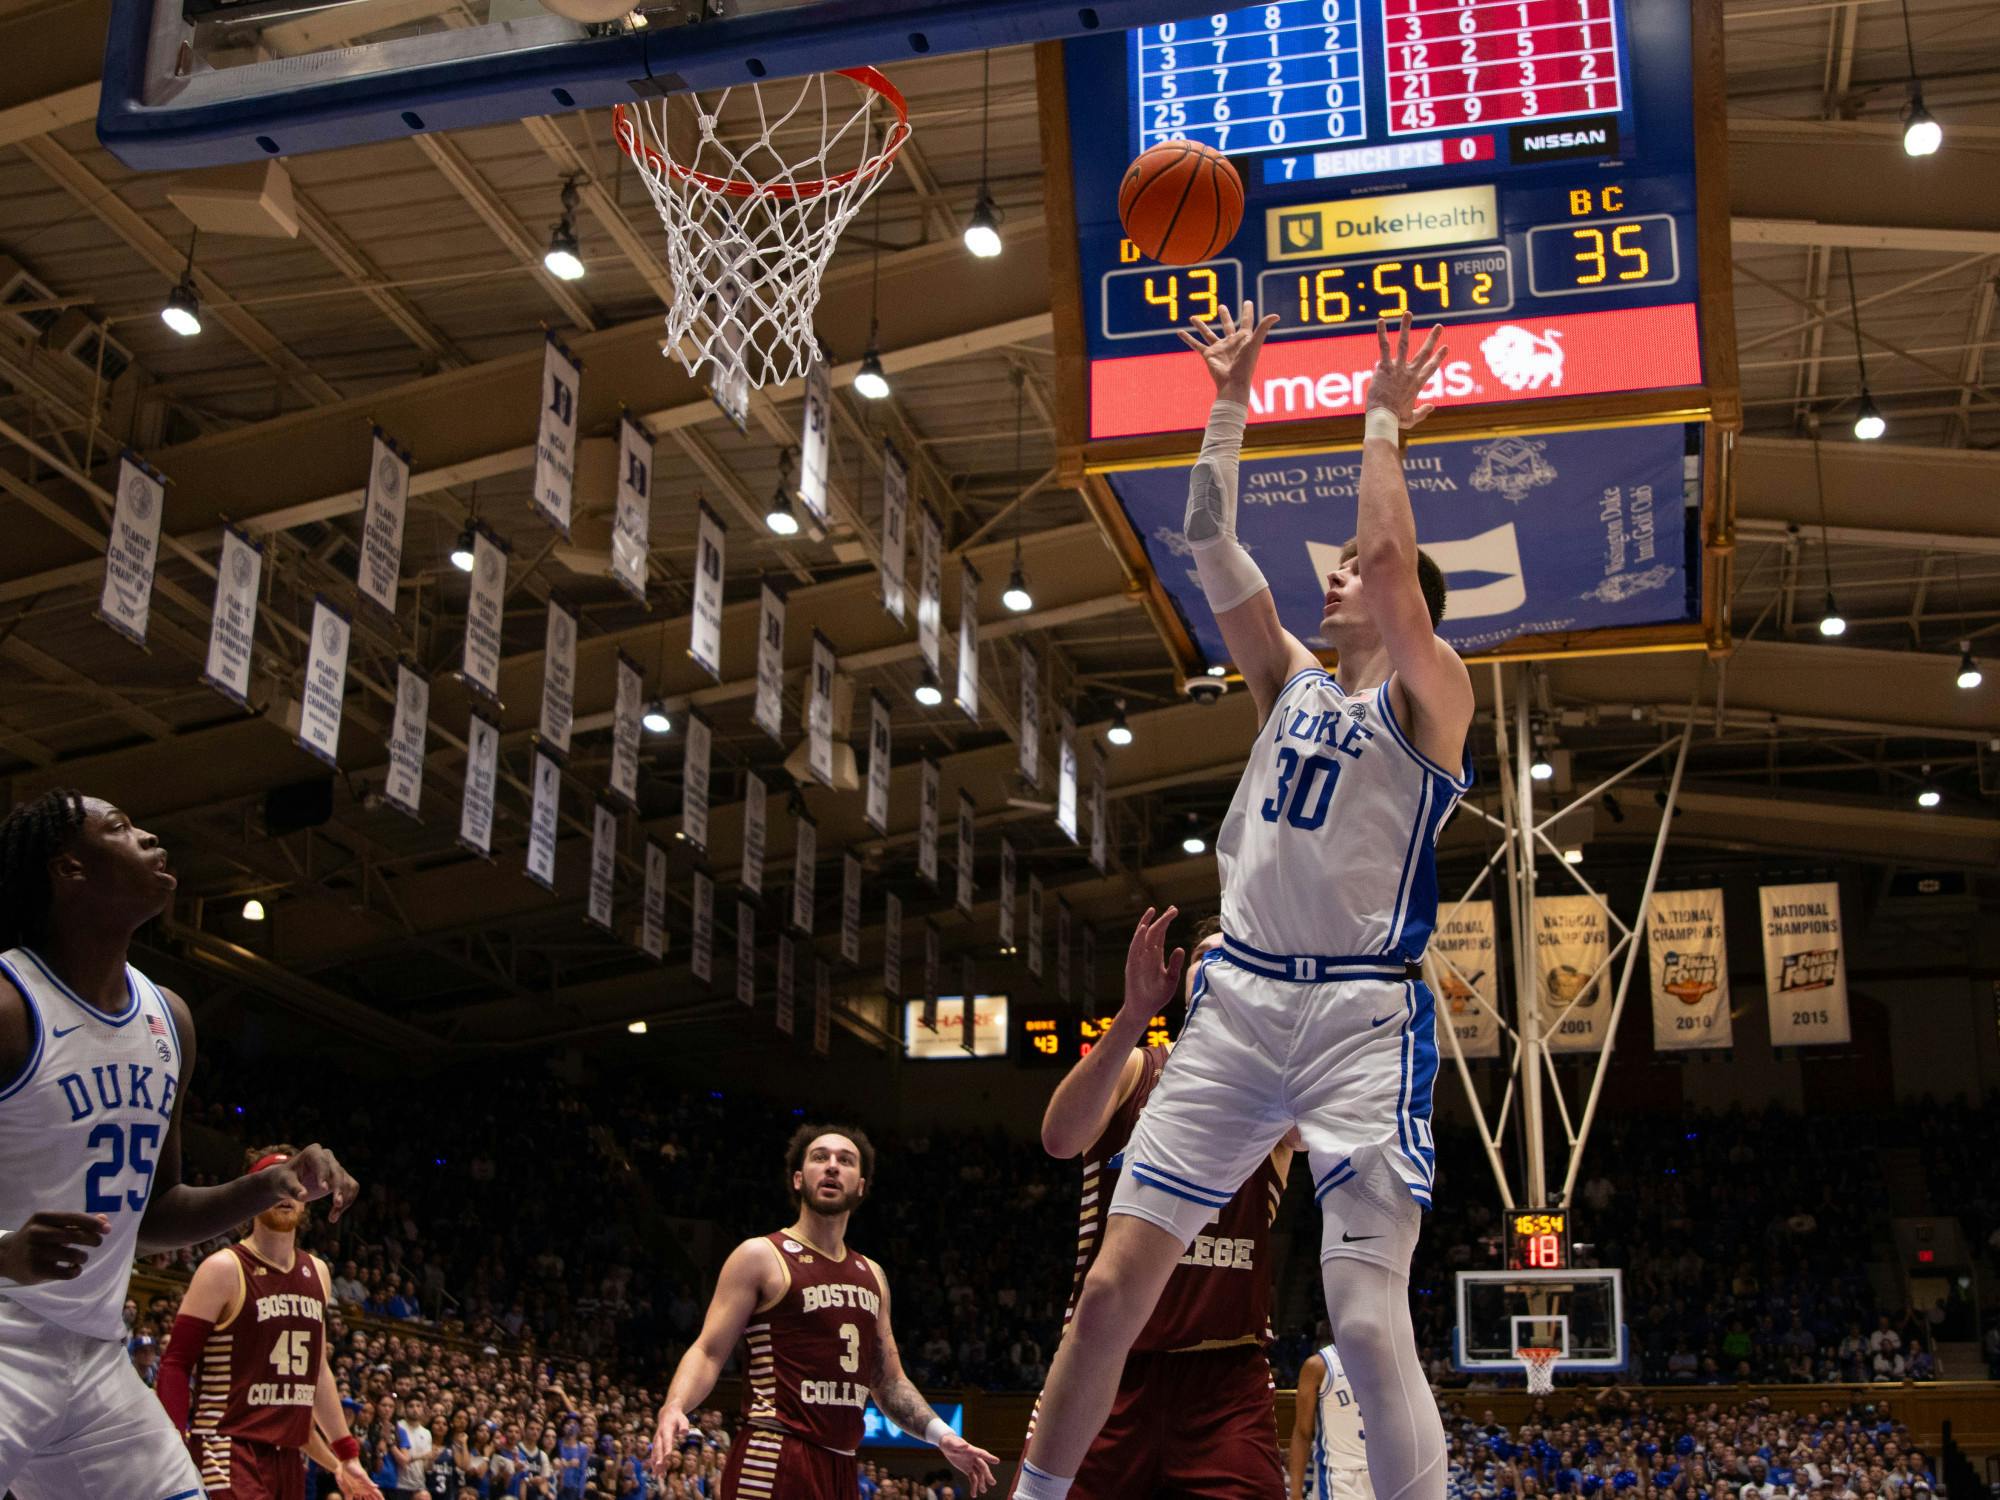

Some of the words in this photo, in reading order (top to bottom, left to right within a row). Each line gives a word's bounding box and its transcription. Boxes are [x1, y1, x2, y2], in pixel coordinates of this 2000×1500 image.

[1159, 23, 1176, 42] 0
[1211, 13, 1228, 36] 9
[1264, 6, 1281, 29] 8
[1322, 0, 1339, 22] 0
[1405, 17, 1422, 40] 3
[1459, 10, 1476, 34] 6
[1517, 3, 1528, 27] 1
[1578, 0, 1589, 20] 1
[1160, 47, 1176, 70] 3
[1213, 40, 1228, 64] 7
[1268, 34, 1278, 57] 1
[1324, 27, 1340, 50] 2
[1400, 45, 1429, 70] 12
[1461, 39, 1477, 63] 2
[1517, 32, 1534, 56] 5
[1580, 26, 1591, 49] 1
[1161, 75, 1177, 99] 5
[1213, 69, 1229, 92] 7
[1267, 62, 1283, 86] 2
[1328, 55, 1338, 79] 1
[1404, 75, 1430, 100] 21
[1462, 68, 1479, 92] 7
[1520, 62, 1536, 86] 3
[1580, 54, 1597, 79] 2
[1154, 103, 1186, 129] 25
[1213, 98, 1230, 121] 6
[1268, 91, 1284, 115] 7
[1326, 84, 1343, 108] 0
[1401, 102, 1436, 129] 45
[1464, 97, 1481, 122] 9
[1521, 91, 1538, 115] 3
[1585, 84, 1596, 109] 1
[1214, 126, 1230, 150] 7
[1268, 119, 1285, 144] 0
[1328, 112, 1345, 137] 0
[1524, 129, 1606, 151] NISSAN
[1282, 157, 1297, 180] 7
[1316, 147, 1391, 177] BENCH
[1404, 141, 1440, 168] PTS
[1459, 138, 1476, 160] 0
[1336, 205, 1485, 239] DukeHealth
[1454, 257, 1505, 276] PERIOD
[1573, 224, 1649, 284] 35
[1144, 268, 1218, 322] 43
[1299, 261, 1449, 323] 16:54
[1471, 273, 1493, 304] 2
[1249, 468, 1308, 489] Club
[1403, 457, 1444, 472] Inn
[1244, 488, 1308, 507] Duke
[1274, 705, 1374, 760] DUKE
[1261, 747, 1342, 831] 30
[1768, 920, 1838, 936] CHAMPIONS
[1772, 903, 1828, 918] NATIONAL
[1784, 965, 1835, 988] FOUR
[1560, 1021, 1592, 1034] 2001
[1677, 1016, 1712, 1029] 2010
[1793, 1011, 1828, 1025] 2015
[1034, 1034, 1059, 1054] 43
[57, 1063, 178, 1122] DUKE
[85, 1123, 160, 1213] 25
[1514, 1215, 1564, 1234] 16:54
[1530, 1235, 1558, 1267] 18
[256, 1294, 323, 1323] BOSTON
[802, 1284, 880, 1320] BOSTON
[269, 1330, 311, 1377] 45
[838, 1323, 860, 1373] 3
